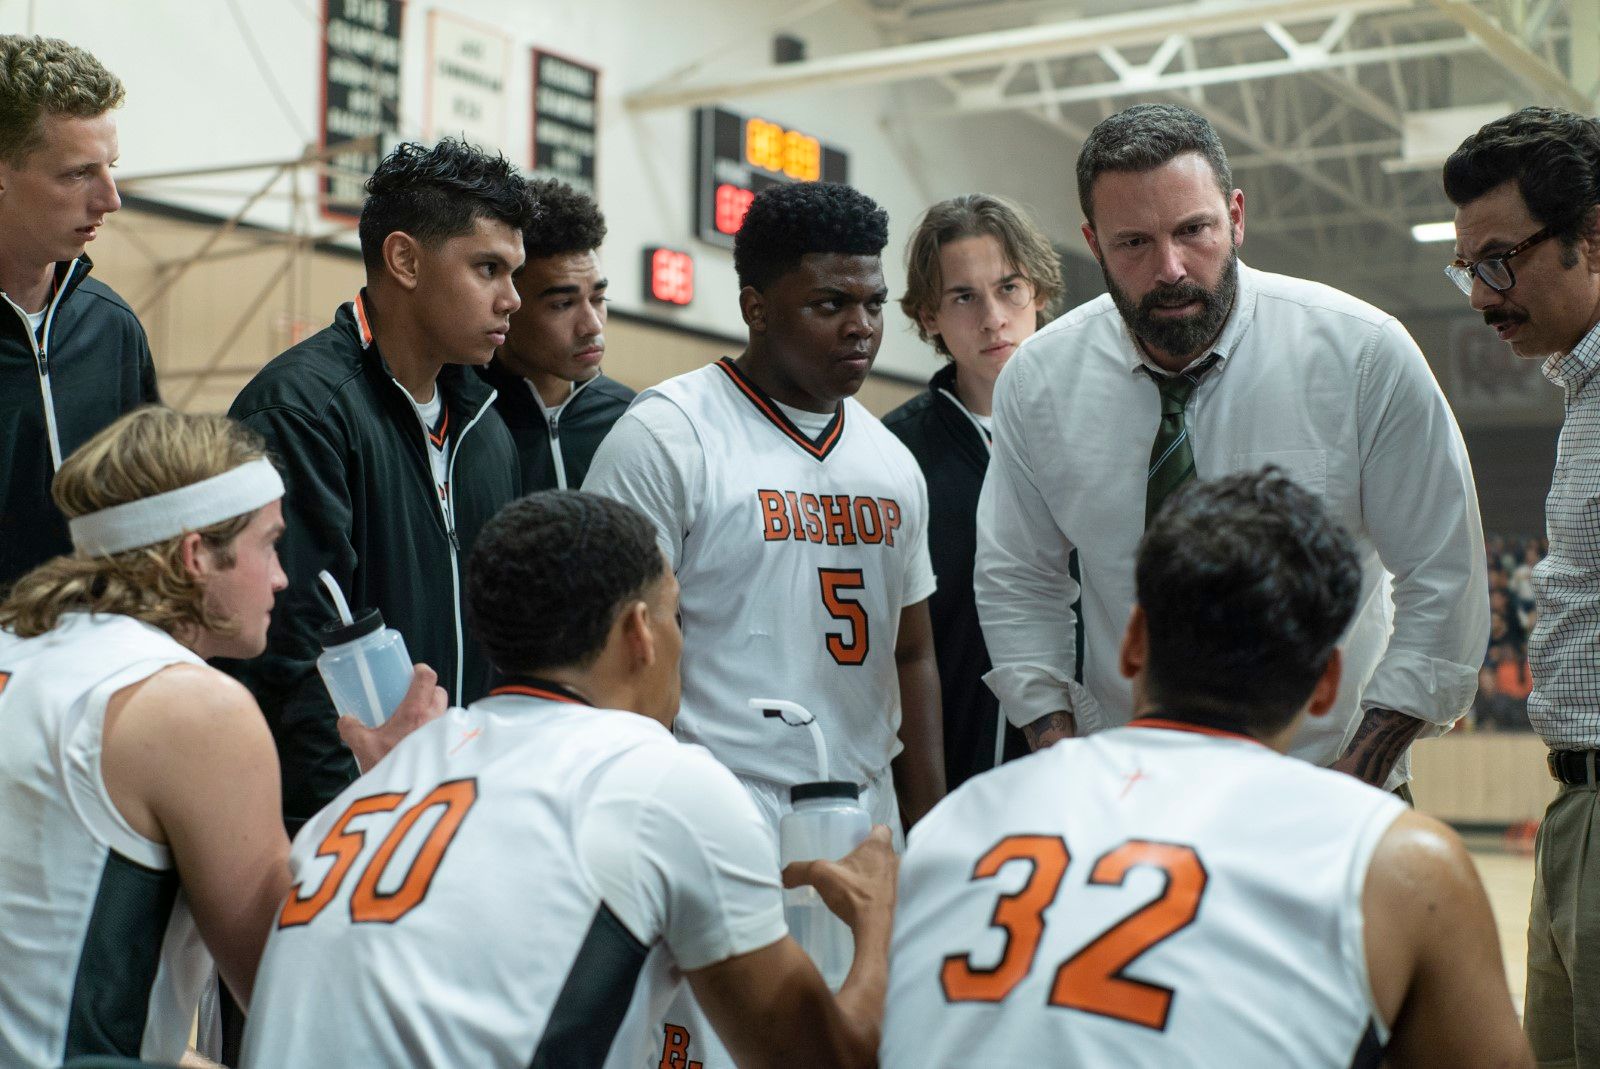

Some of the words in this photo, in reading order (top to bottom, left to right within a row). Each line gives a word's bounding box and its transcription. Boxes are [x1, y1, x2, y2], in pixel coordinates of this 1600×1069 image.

[757, 489, 901, 547] BISHOP
[817, 567, 869, 666] 5
[277, 776, 478, 930] 50
[939, 833, 1209, 1033] 32
